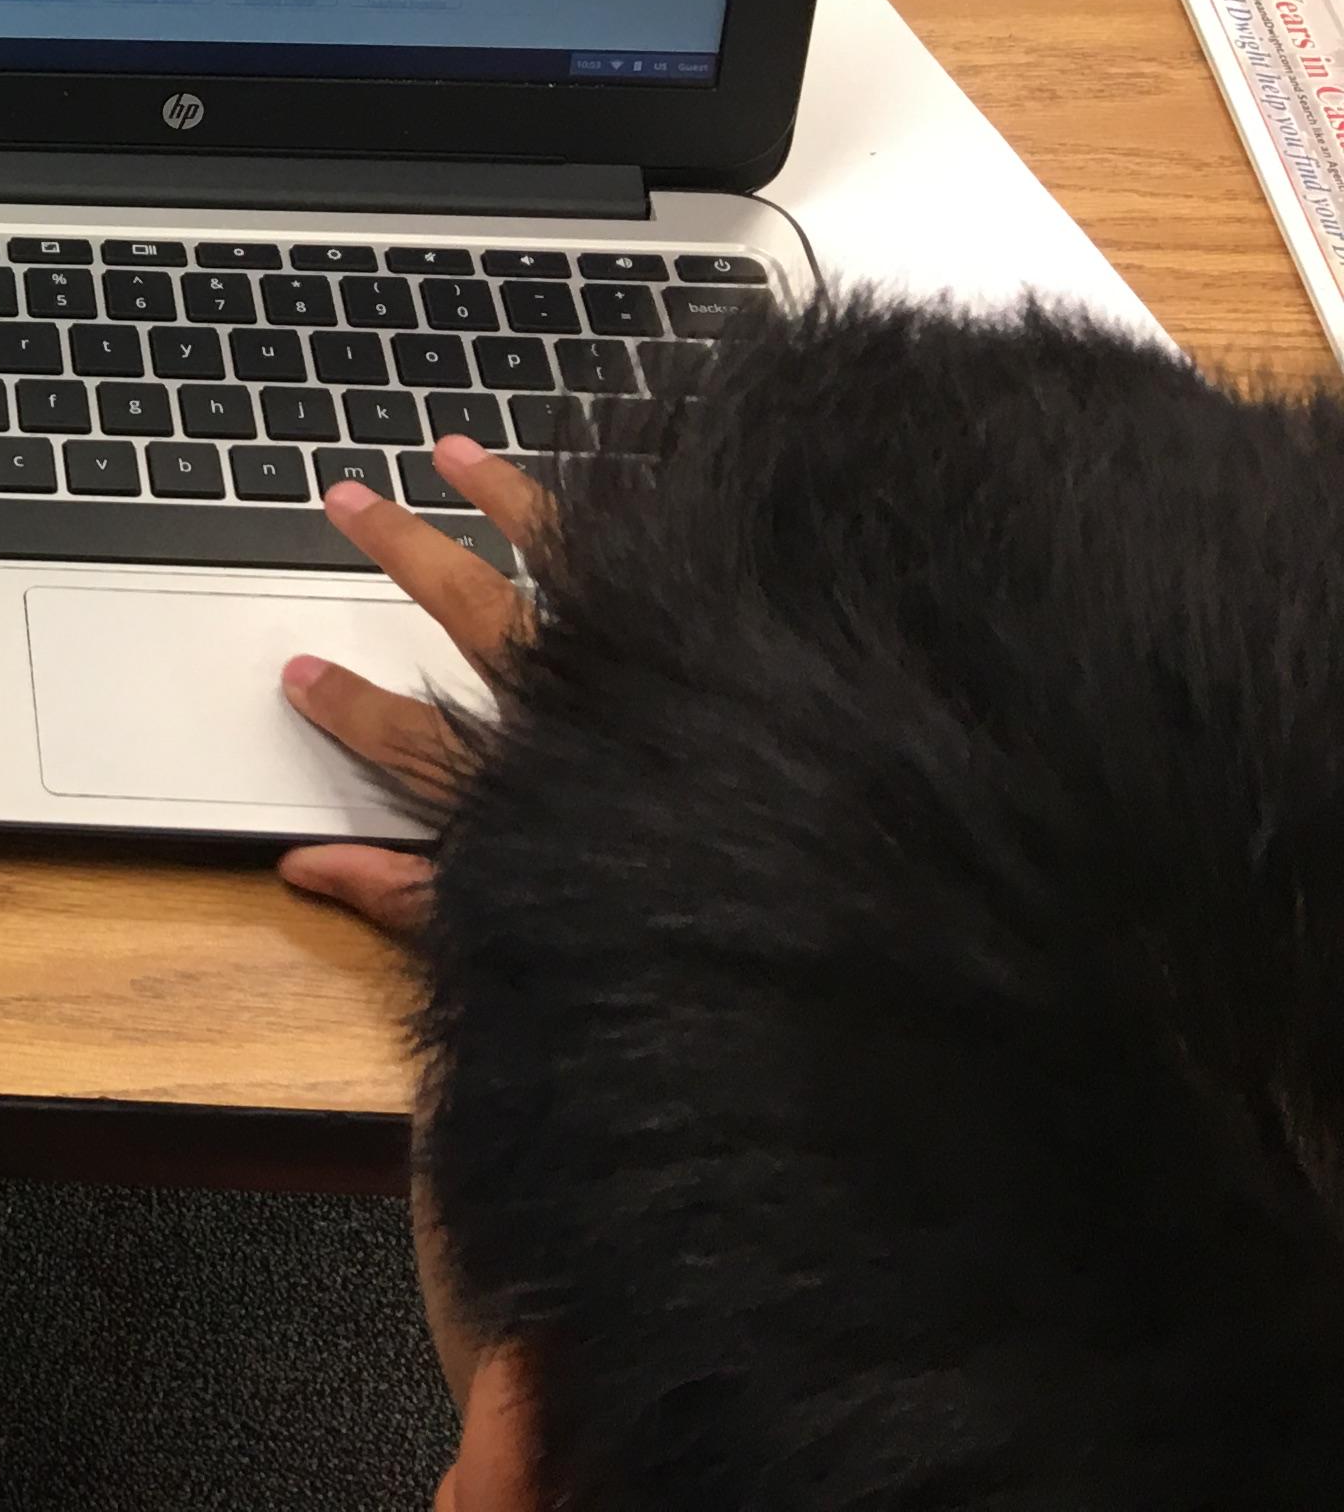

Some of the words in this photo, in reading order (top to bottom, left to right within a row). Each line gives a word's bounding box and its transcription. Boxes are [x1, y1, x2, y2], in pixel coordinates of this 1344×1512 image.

[1226, 6, 1268, 68] Dwight
[1301, 56, 1334, 79] in
[1254, 72, 1288, 112] help
[1284, 76, 1305, 93] and
[167, 93, 201, 129] hp
[1293, 94, 1318, 126] Search
[1268, 114, 1303, 149] you
[1308, 126, 1329, 146] like
[1319, 144, 1333, 159] an
[1286, 151, 1320, 192] find
[1305, 195, 1341, 241] your
[22, 340, 28, 349] r
[181, 345, 191, 357] y
[179, 459, 191, 472] b
[345, 468, 364, 477] m
